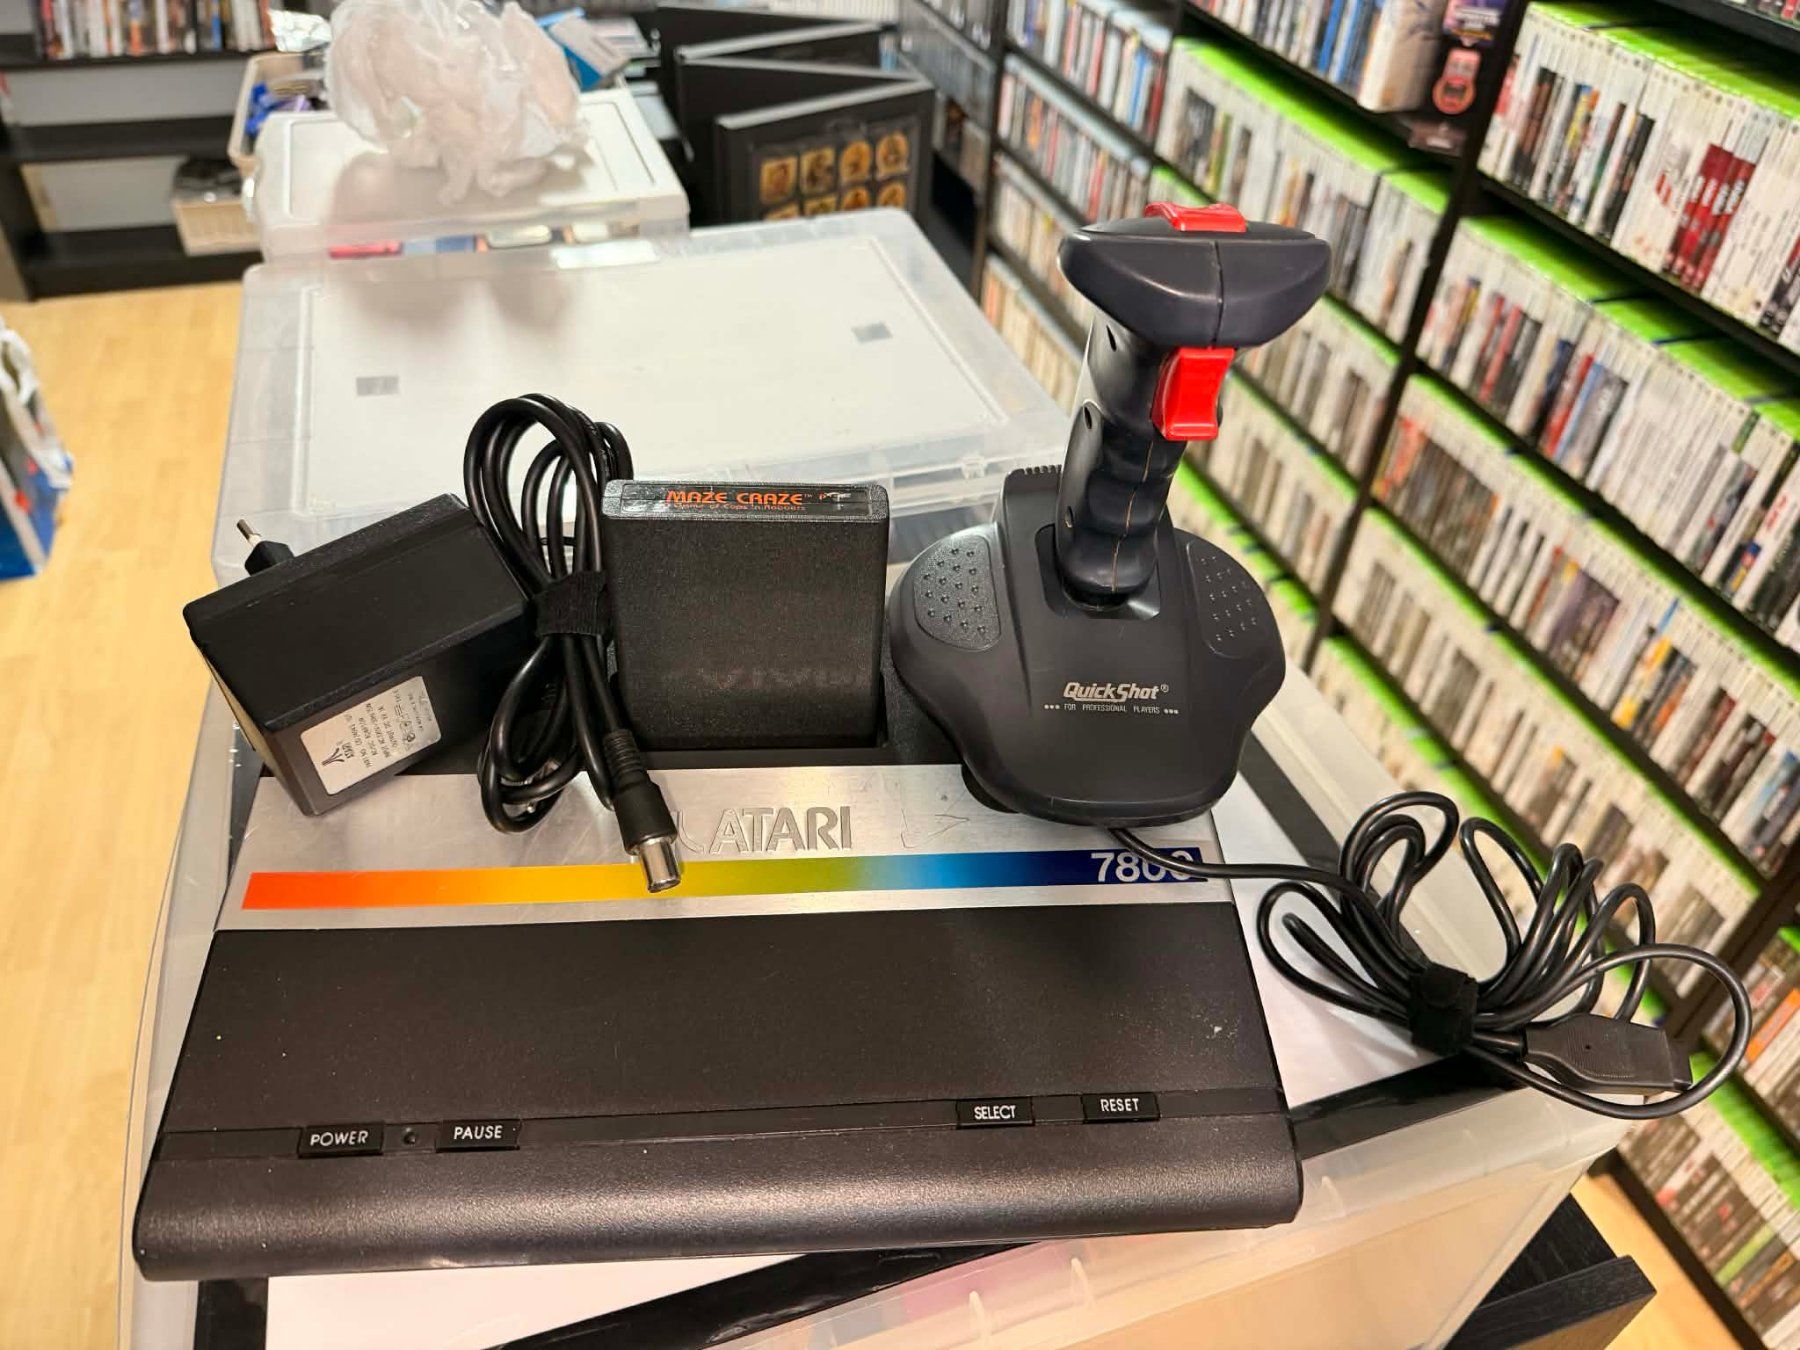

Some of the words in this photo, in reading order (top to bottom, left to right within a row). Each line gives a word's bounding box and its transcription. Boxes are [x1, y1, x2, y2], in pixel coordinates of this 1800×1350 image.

[665, 490, 727, 504] MAZE
[736, 492, 803, 505] CRAZE
[1064, 703, 1077, 711] FOR
[1082, 704, 1127, 713] PROFESSIONAL
[1133, 705, 1160, 714] PLAYERS
[708, 805, 852, 854] ATARI
[973, 1105, 1017, 1120] SELECT
[1100, 1098, 1140, 1112] RESET
[309, 1130, 369, 1146] POWER
[453, 1125, 503, 1140] PAUSE
